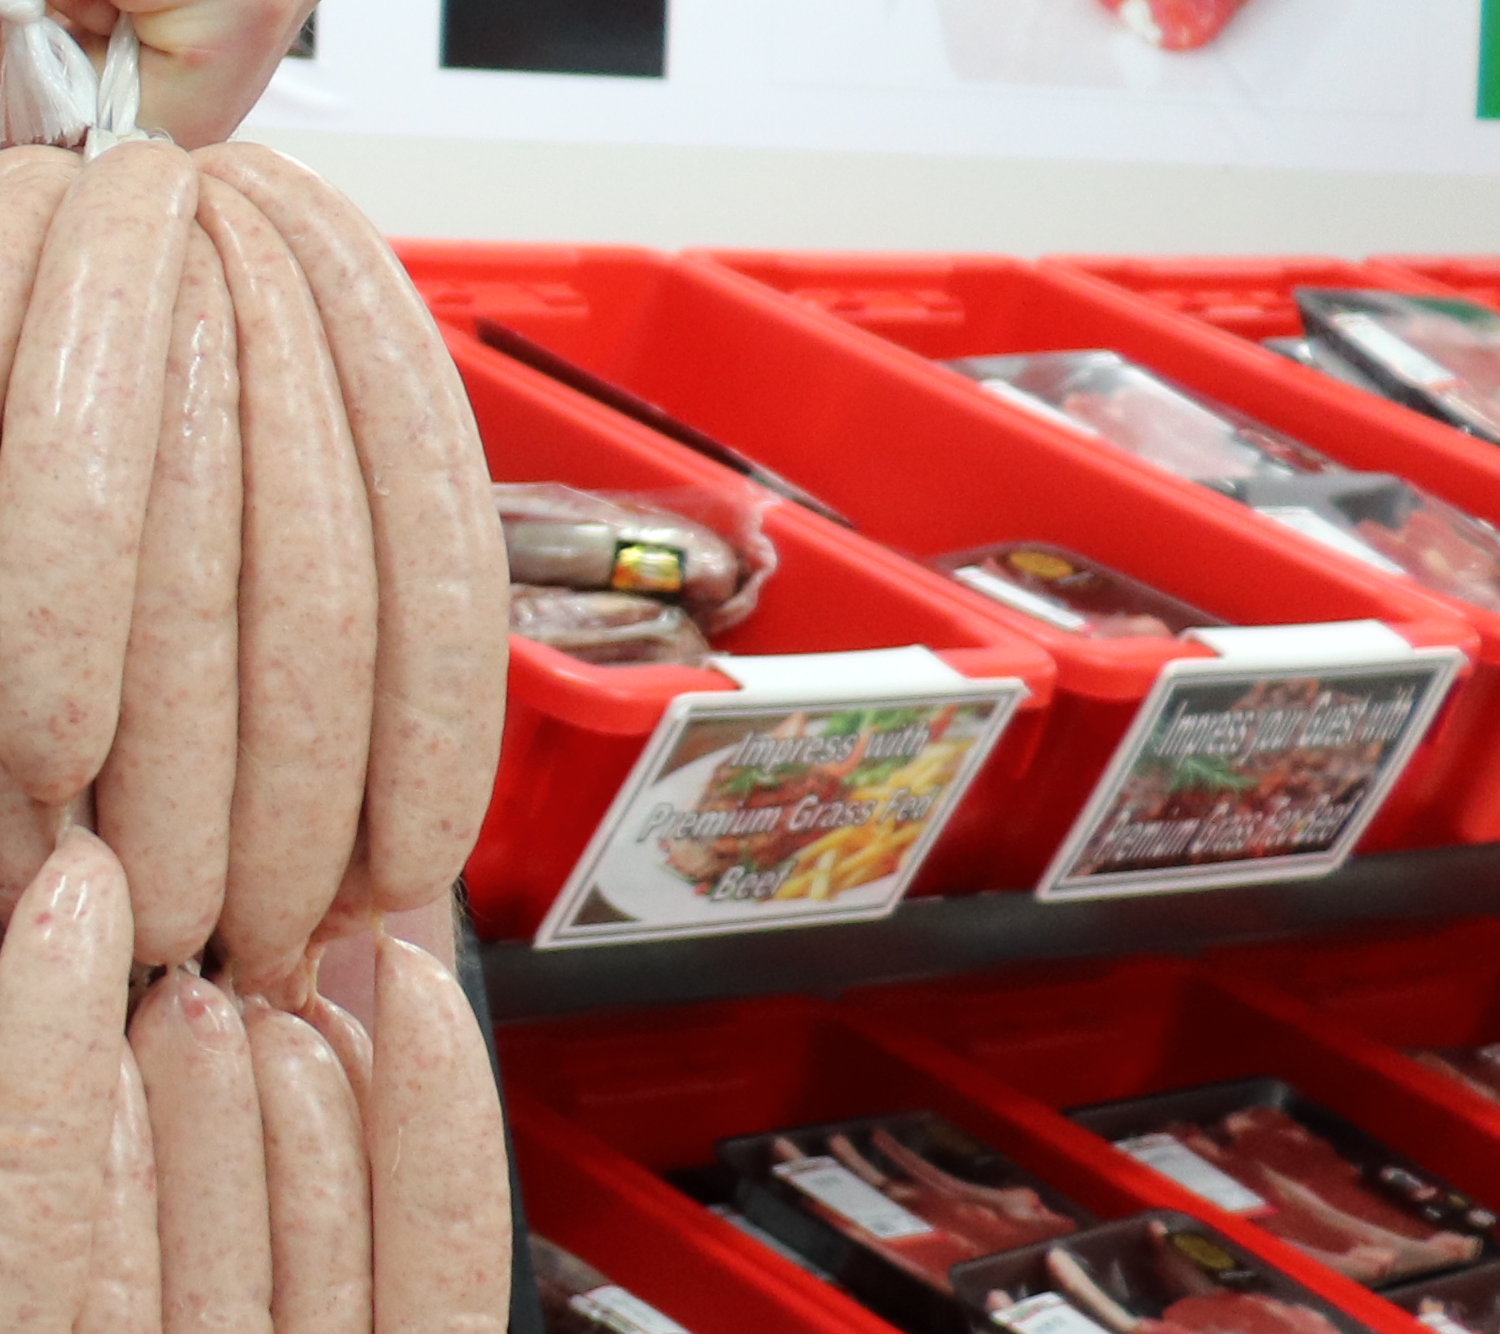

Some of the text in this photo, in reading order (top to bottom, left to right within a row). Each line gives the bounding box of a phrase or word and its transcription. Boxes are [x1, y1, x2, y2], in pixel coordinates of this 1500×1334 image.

[730, 724, 930, 782] Impress with
[1158, 700, 1256, 768] Impress
[1298, 692, 1372, 747] Guest
[1361, 686, 1416, 741] with
[637, 789, 937, 843] Premium Grass Fed
[710, 859, 798, 902] Beef
